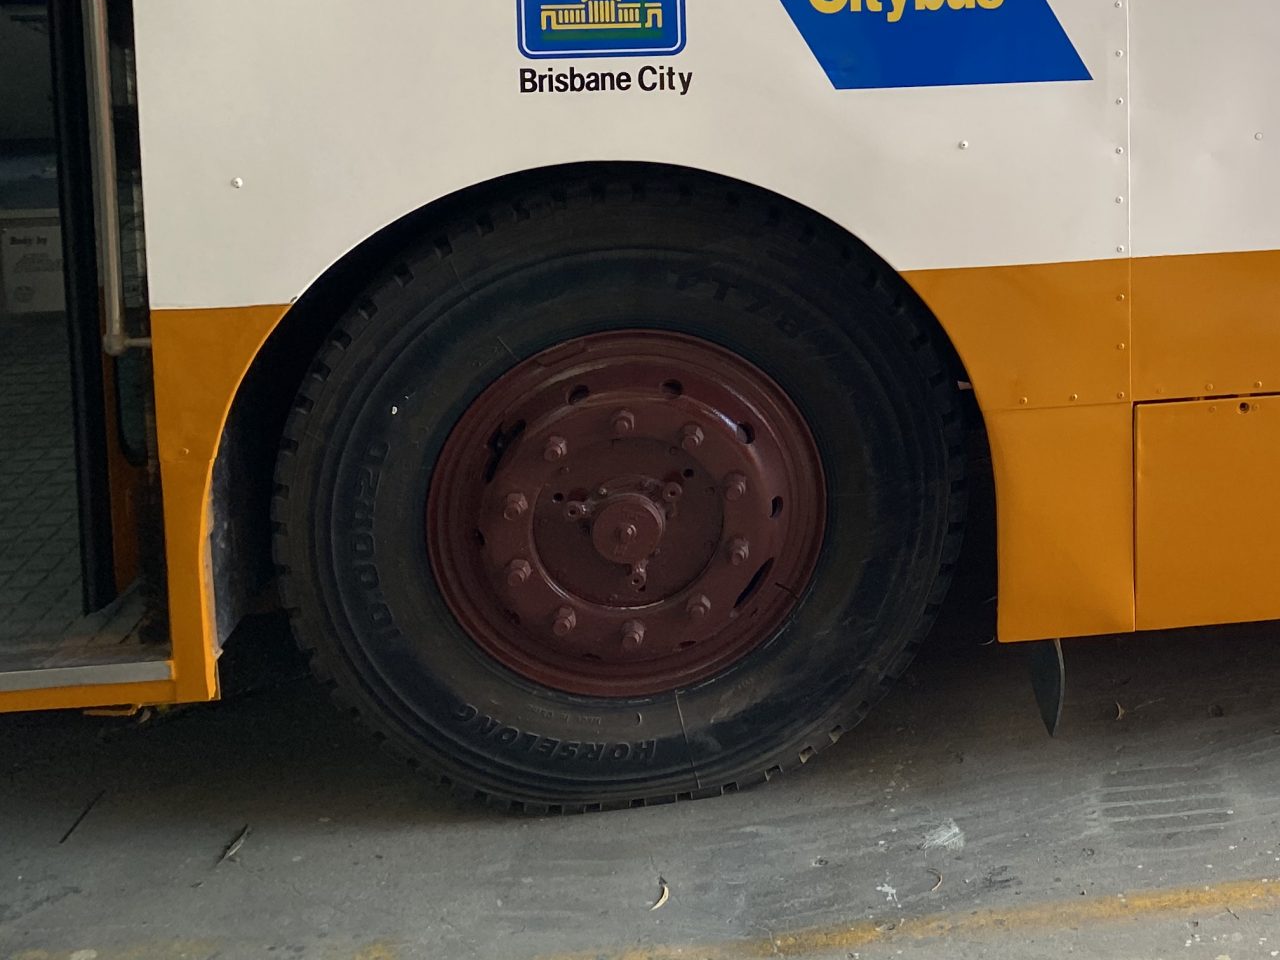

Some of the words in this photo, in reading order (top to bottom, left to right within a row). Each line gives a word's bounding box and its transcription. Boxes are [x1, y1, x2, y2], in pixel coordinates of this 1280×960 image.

[519, 66, 632, 93] Brisbane
[637, 65, 693, 96] City
[452, 702, 658, 762] HORSELONG
